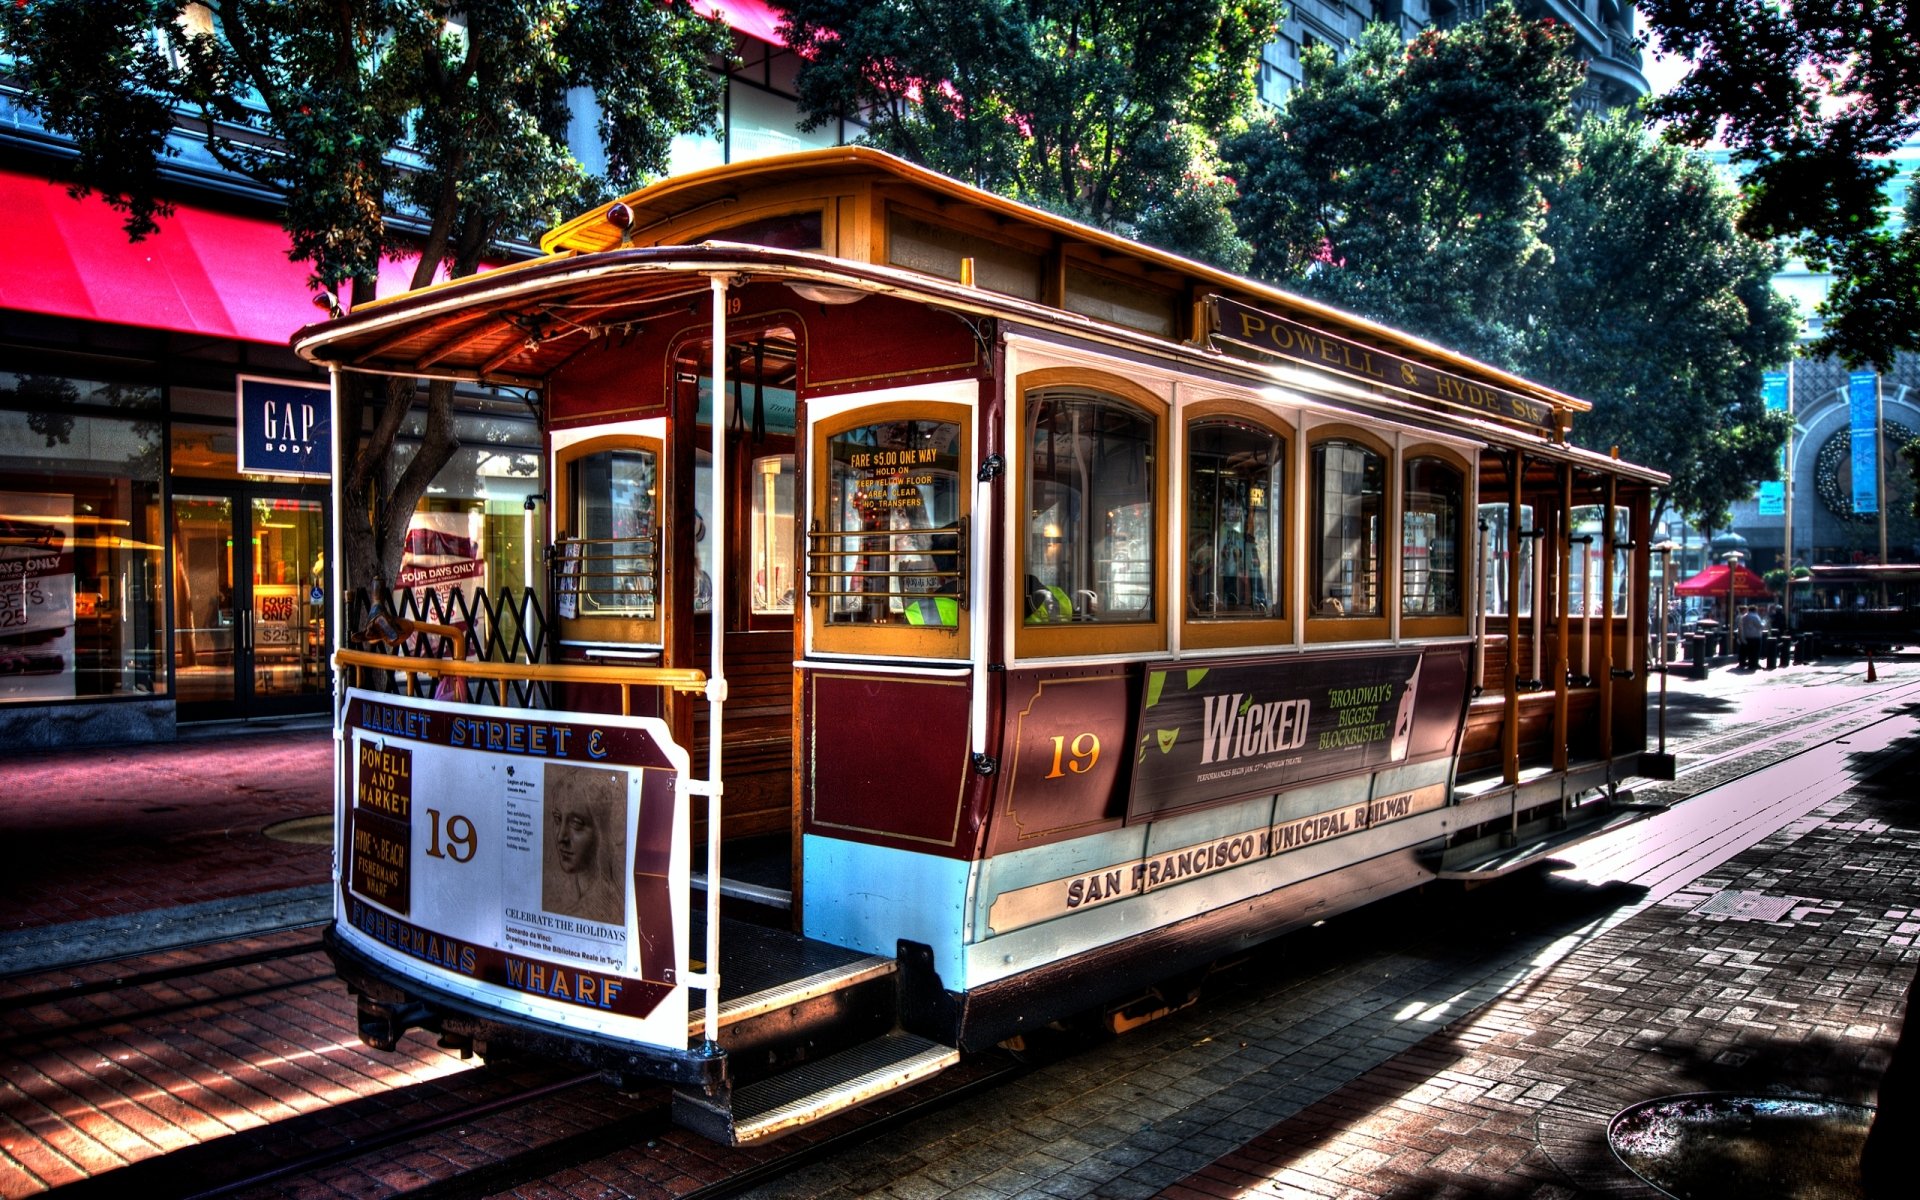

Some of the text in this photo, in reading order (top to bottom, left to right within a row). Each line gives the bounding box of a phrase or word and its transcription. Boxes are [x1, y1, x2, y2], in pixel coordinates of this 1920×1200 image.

[726, 297, 741, 314] 19
[1238, 311, 1384, 379] POWELL
[1400, 363, 1420, 386] &
[1435, 374, 1501, 410] HYDE
[264, 400, 314, 442] GAP
[265, 443, 312, 455] BODY
[851, 448, 938, 468] FARE $5.00 ONE WAY
[875, 478, 904, 487] YELLOW
[906, 476, 932, 485] FLOOR
[876, 466, 909, 476] HOLD ON
[863, 498, 921, 508] NO TRANSFERS
[868, 488, 916, 498] AREA CLEAR
[25, 556, 61, 571] ONLY
[402, 571, 427, 583] FOUR
[429, 566, 452, 578] DAYS
[453, 563, 476, 574] ONLY
[263, 597, 293, 605] FOUR
[263, 604, 293, 612] DAYS
[262, 611, 292, 621] ONLY
[263, 629, 290, 641] $25
[1338, 705, 1379, 727] BIGGEST
[363, 703, 431, 739] MARKET
[451, 716, 572, 757] STREET
[361, 747, 409, 778] POWELL
[1043, 732, 1101, 780] 19
[371, 772, 395, 790] AND
[360, 782, 409, 816] MARKET
[425, 807, 478, 863] 19
[355, 828, 372, 855] HYDE
[381, 838, 404, 868] BEACH
[1066, 794, 1413, 909] SAN FRANCISCO MUNICIPAL RAILWAY
[358, 856, 399, 888] FISHERMANS
[366, 876, 388, 898] WHARF
[505, 907, 626, 942] CELEBRATE THE HOLIDAYS
[506, 925, 529, 937] Leonardo
[352, 901, 622, 1009] FISHERMANS WHARF
[506, 934, 528, 946] Drawings
[530, 940, 541, 949] from
[543, 943, 551, 951] the
[552, 945, 581, 958] Biblioteca
[581, 951, 599, 962] Reale
